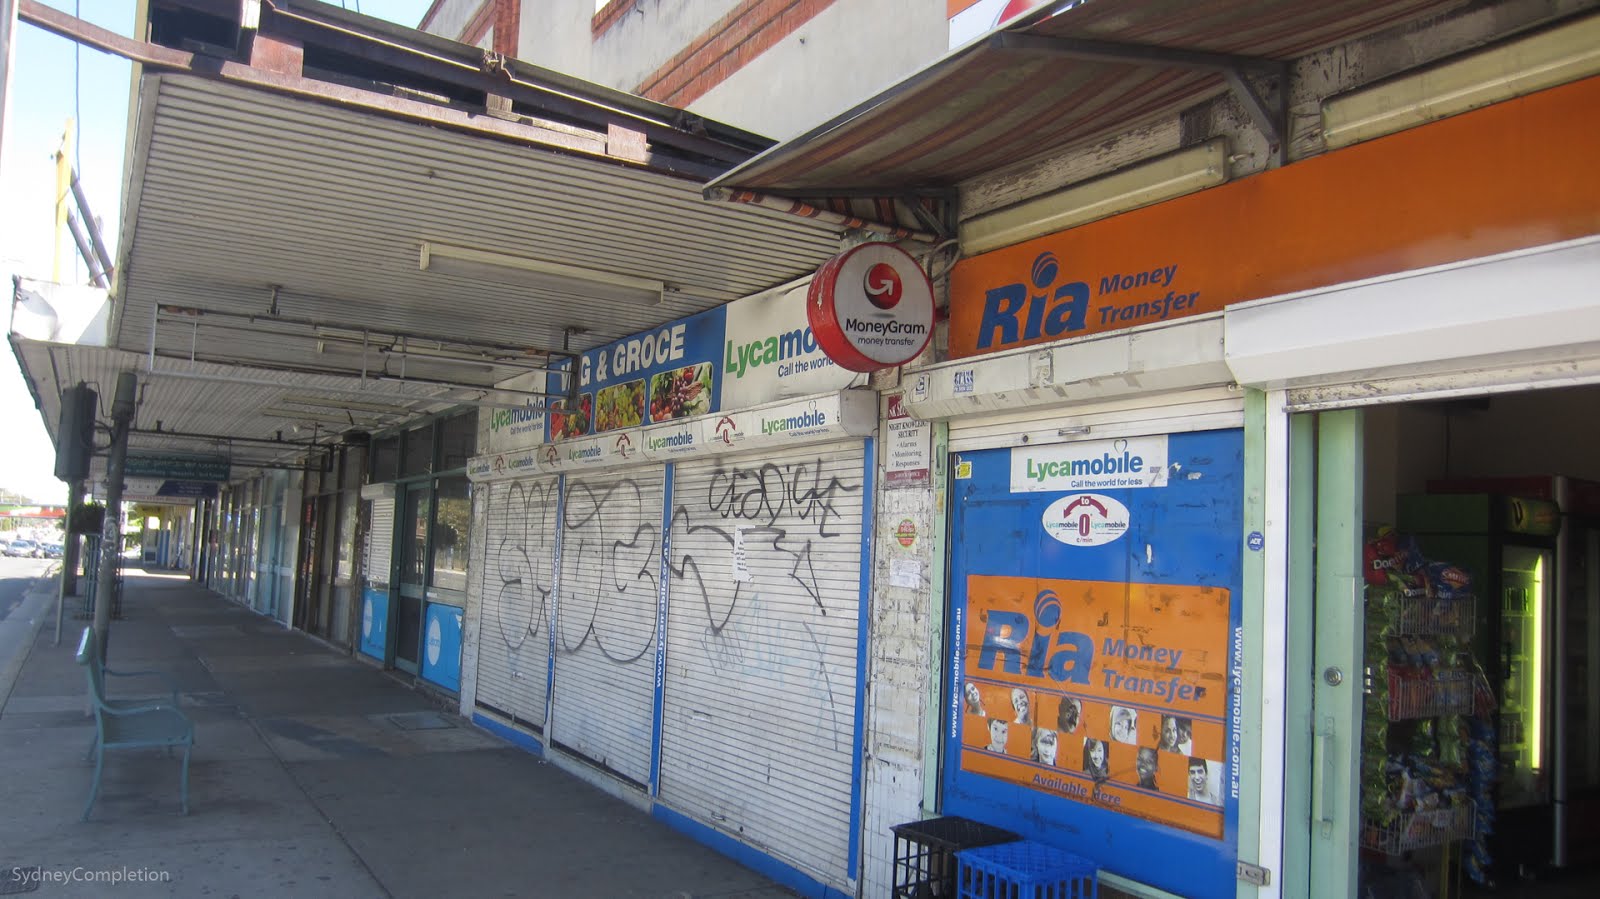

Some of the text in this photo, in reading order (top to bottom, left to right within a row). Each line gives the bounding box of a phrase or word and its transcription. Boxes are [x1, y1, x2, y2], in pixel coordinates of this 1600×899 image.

[1099, 264, 1178, 296] Money
[976, 252, 1090, 350] Ria
[1098, 289, 1200, 326] Transfer
[857, 335, 915, 347] money transfer
[560, 323, 686, 392] VG & GROCE
[777, 362, 794, 377] Call
[795, 360, 809, 373] the
[761, 409, 826, 435] Lycamobile
[648, 431, 693, 451] Lycamobile
[898, 430, 919, 439] SECURITY
[899, 441, 917, 449] Alarms
[568, 444, 602, 461] Lycamobile
[894, 450, 922, 459] Monitoring
[895, 459, 921, 469] Responses
[1027, 451, 1144, 482] Lycamobile
[1071, 477, 1143, 488] Call the world for less
[1081, 496, 1090, 505] to
[1046, 521, 1078, 529] Lycamobile
[1091, 521, 1126, 529] Lycamobile
[1249, 537, 1262, 546] ADT
[977, 589, 1096, 686] Ria
[1101, 637, 1183, 670] Money
[950, 607, 962, 738] www.lycamobile.com.au
[1101, 668, 1206, 704] Transfer
[1231, 626, 1243, 799] www.lycamobile.com.au
[1032, 773, 1088, 798] Available
